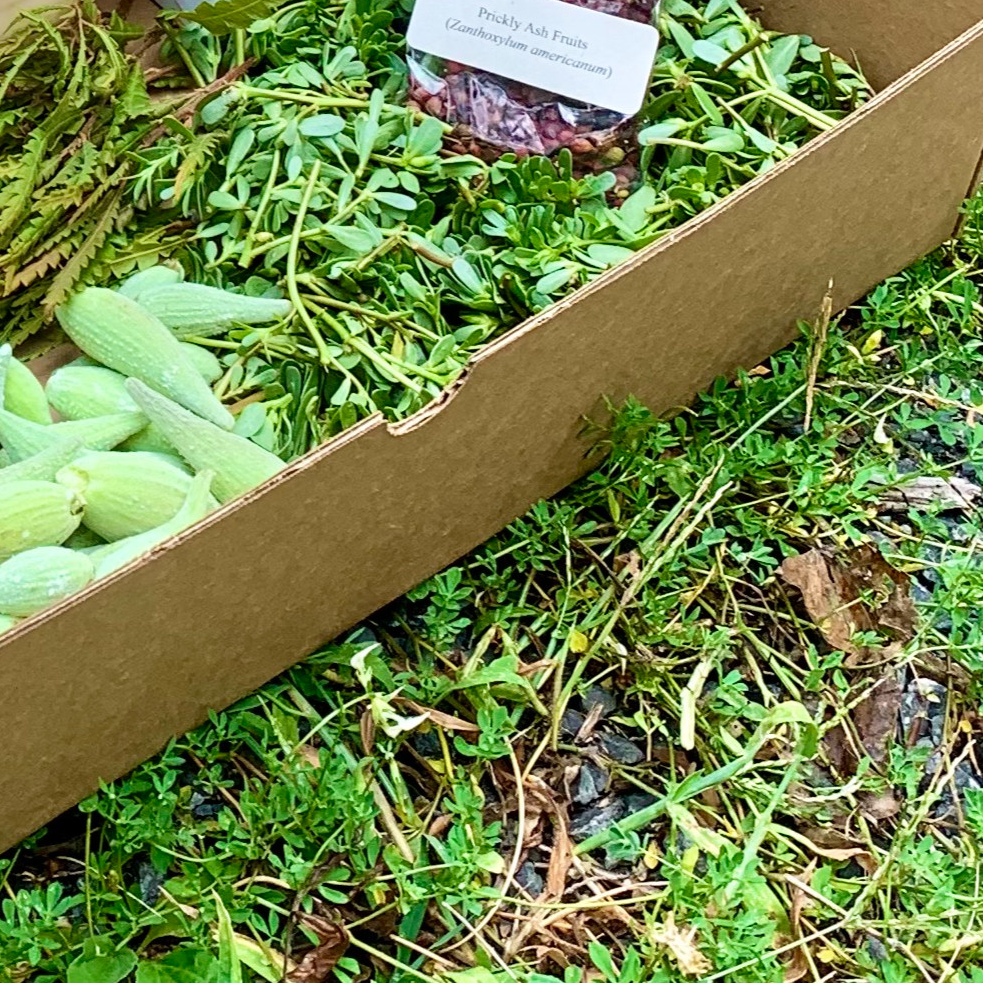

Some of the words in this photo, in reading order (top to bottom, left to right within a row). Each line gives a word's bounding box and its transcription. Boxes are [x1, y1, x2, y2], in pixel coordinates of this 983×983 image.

[445, 17, 528, 52] (Zanthoxylum
[530, 47, 613, 79] americanum)
[477, 6, 522, 31] Prickly
[524, 21, 548, 39] Ash
[552, 30, 588, 50] Fruits
